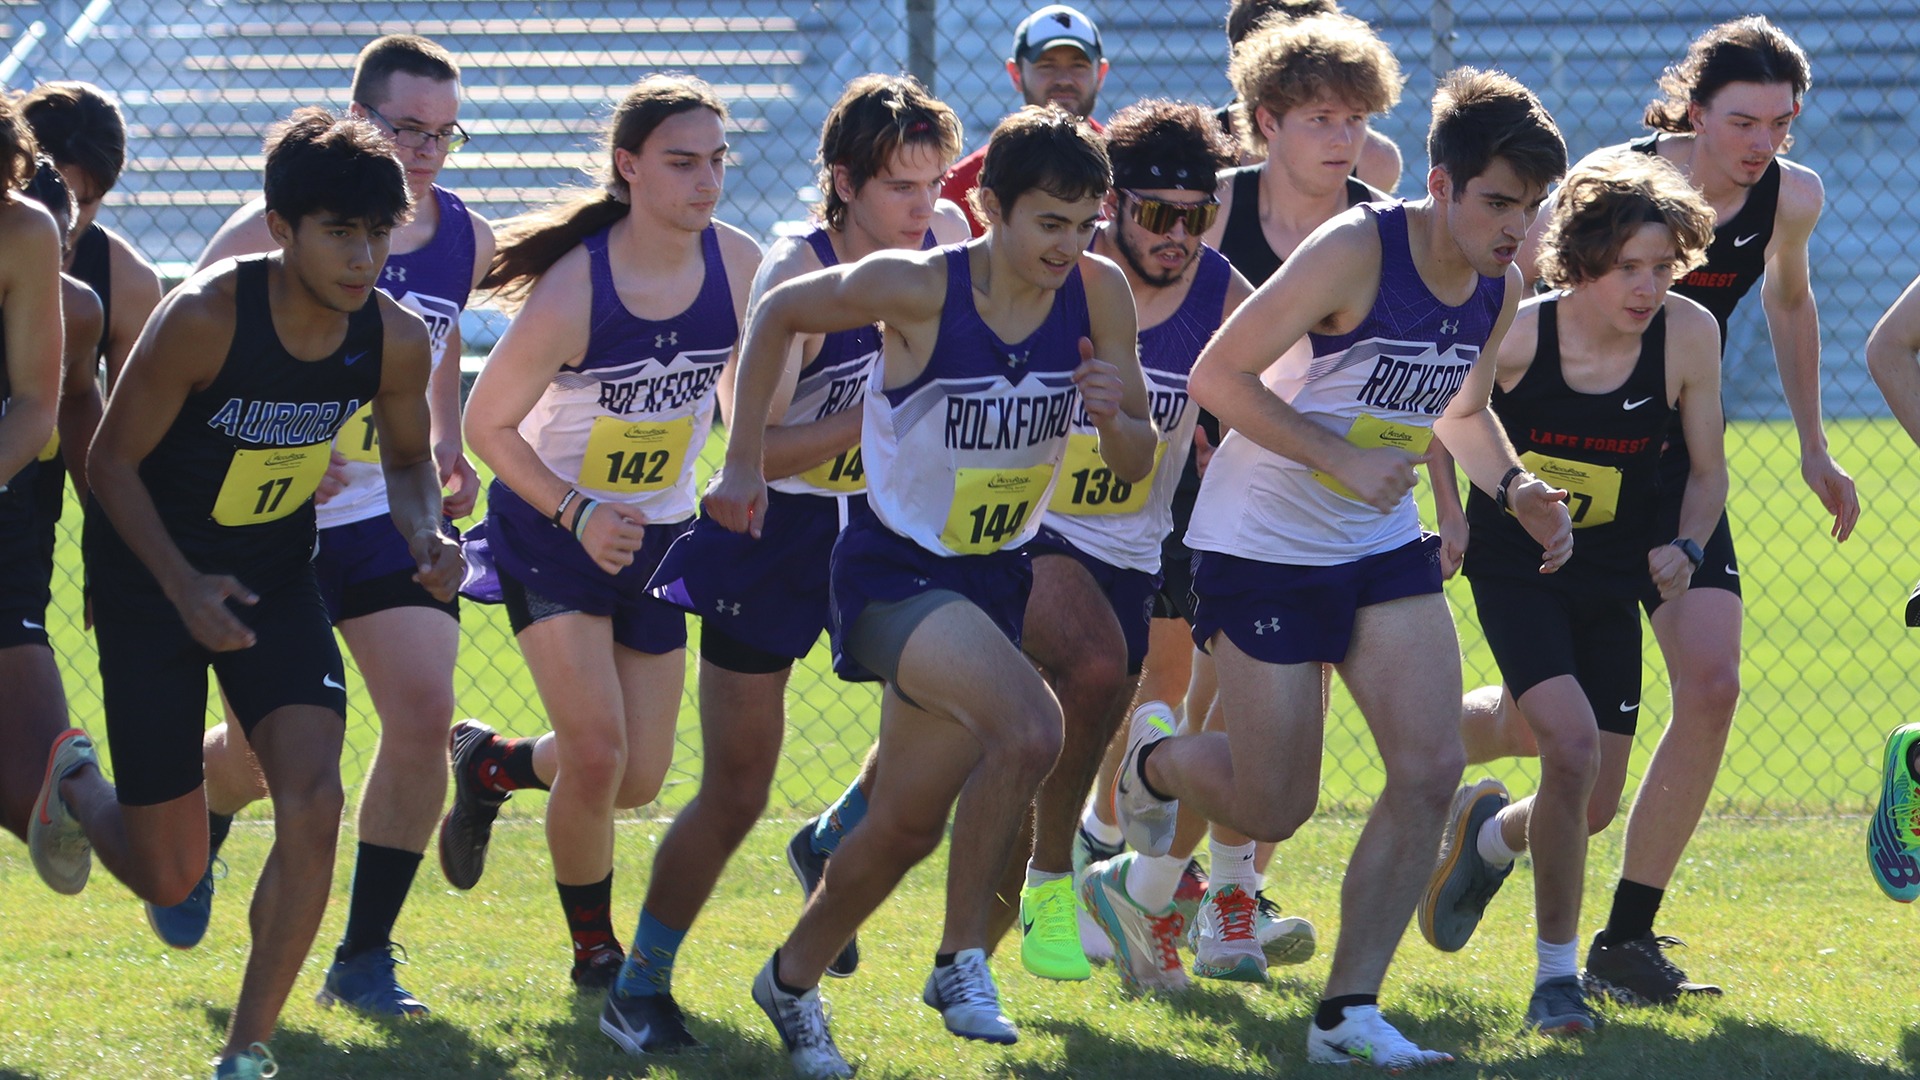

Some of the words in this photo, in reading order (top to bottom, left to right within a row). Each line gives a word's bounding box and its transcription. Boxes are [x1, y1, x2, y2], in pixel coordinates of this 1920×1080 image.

[1676, 271, 1739, 288] OREST
[944, 386, 1077, 450] ROCKFORD
[1530, 428, 1579, 448] LAKE
[1583, 437, 1650, 454] FOREST
[606, 449, 670, 484] 142
[827, 446, 865, 482] 14
[253, 476, 295, 515] 17
[969, 500, 1029, 544] 144
